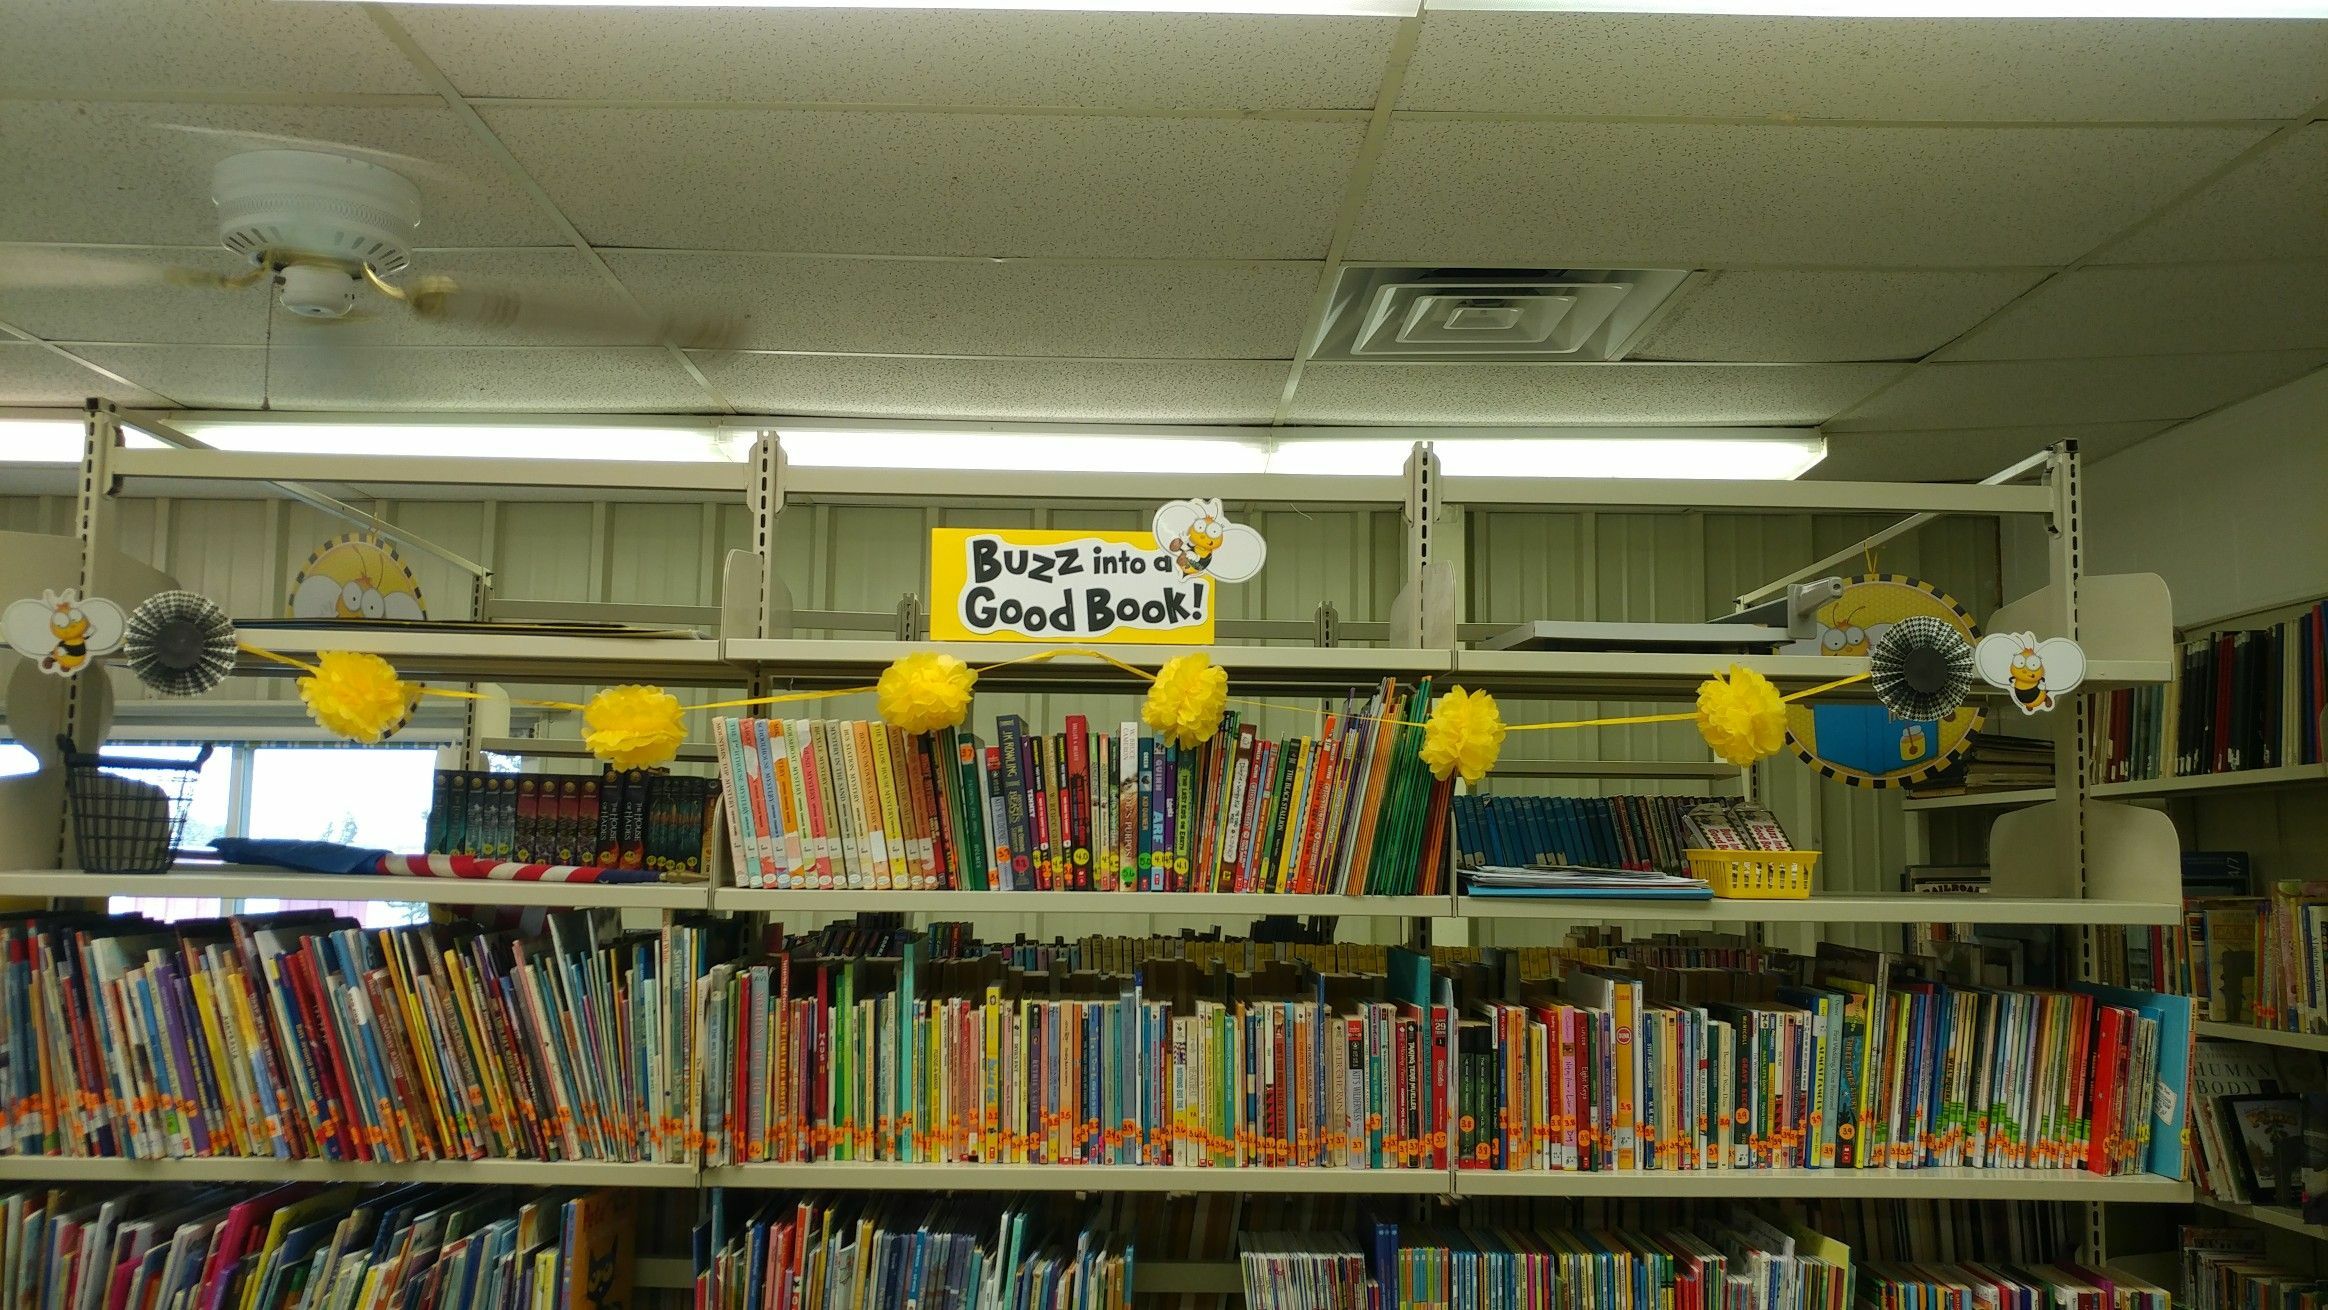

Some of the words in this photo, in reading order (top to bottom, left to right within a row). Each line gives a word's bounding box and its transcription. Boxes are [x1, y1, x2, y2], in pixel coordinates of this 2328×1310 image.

[1093, 546, 1146, 574] into
[1154, 555, 1172, 573] a
[965, 586, 1076, 632] Good
[1086, 583, 1204, 632] Book!
